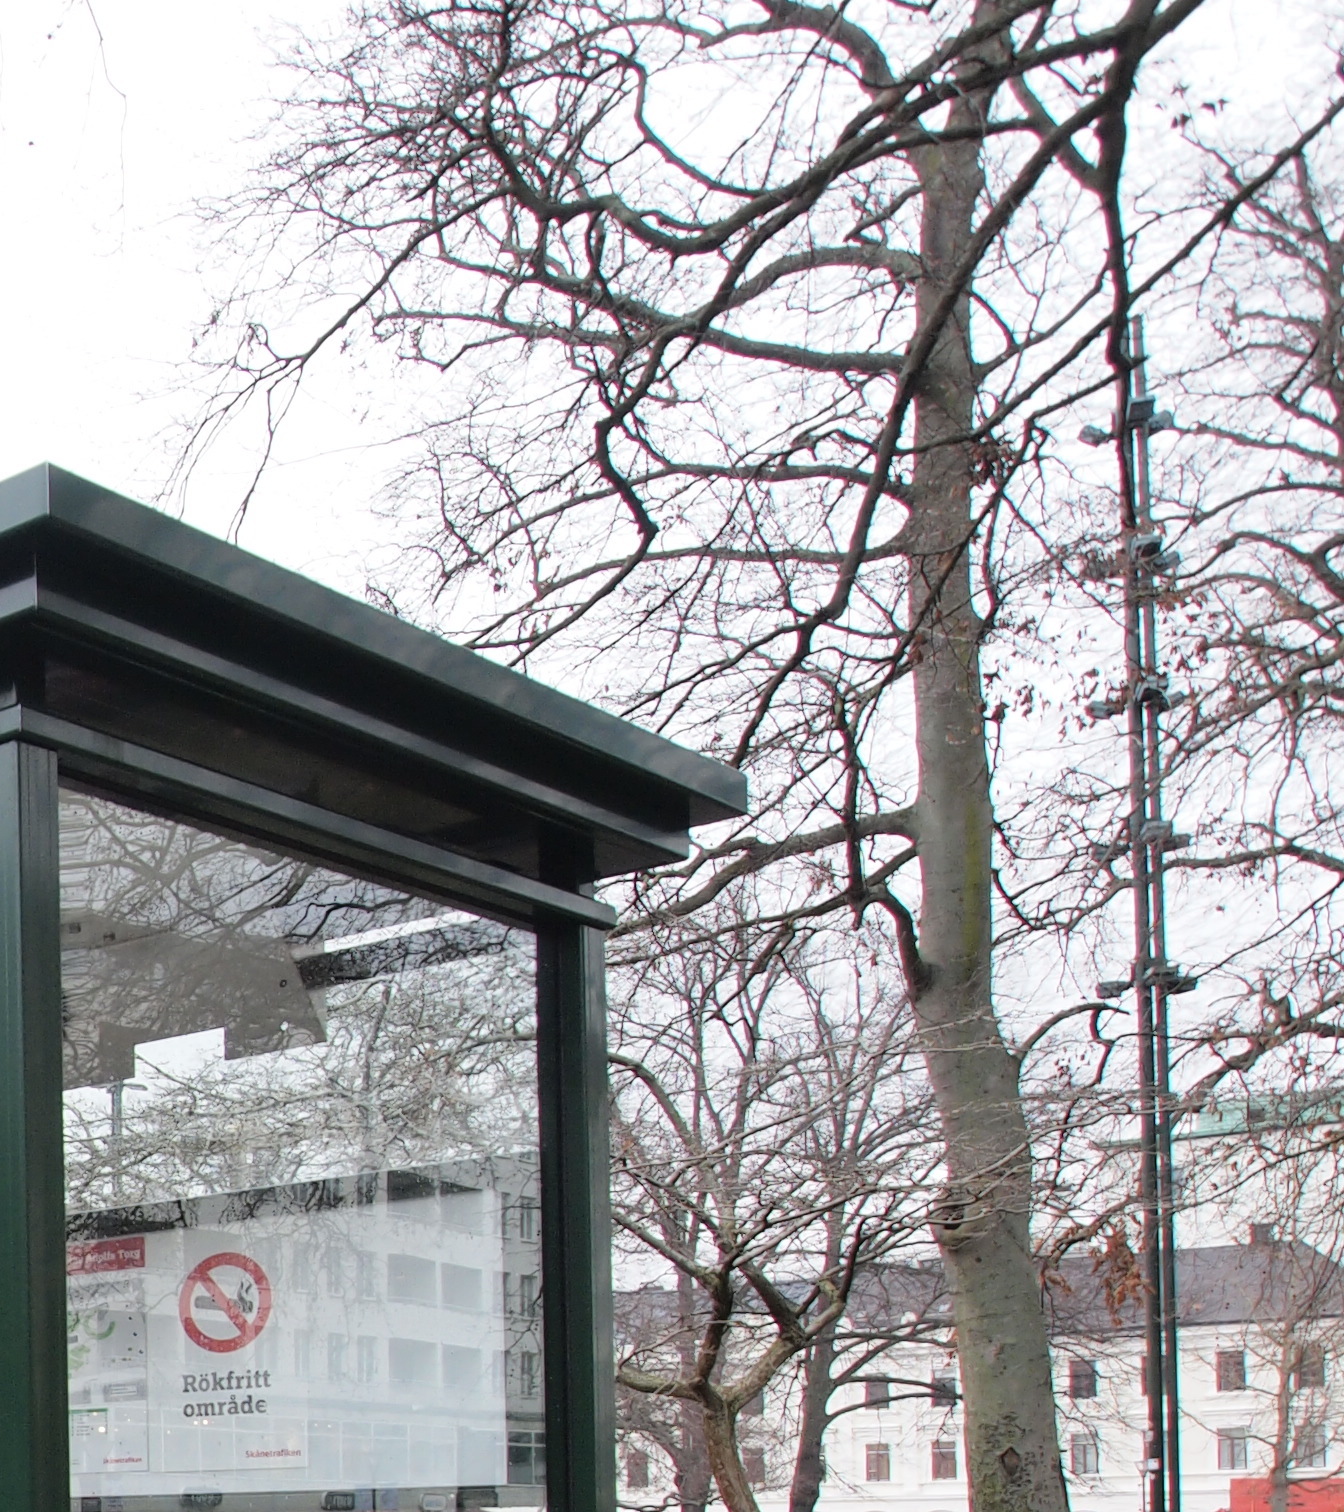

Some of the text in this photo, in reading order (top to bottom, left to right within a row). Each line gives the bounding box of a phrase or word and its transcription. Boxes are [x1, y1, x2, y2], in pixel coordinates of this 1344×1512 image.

[183, 1369, 271, 1393] Rökfritt
[183, 1395, 268, 1418] område
[245, 1448, 302, 1459] Skånetrafiken
